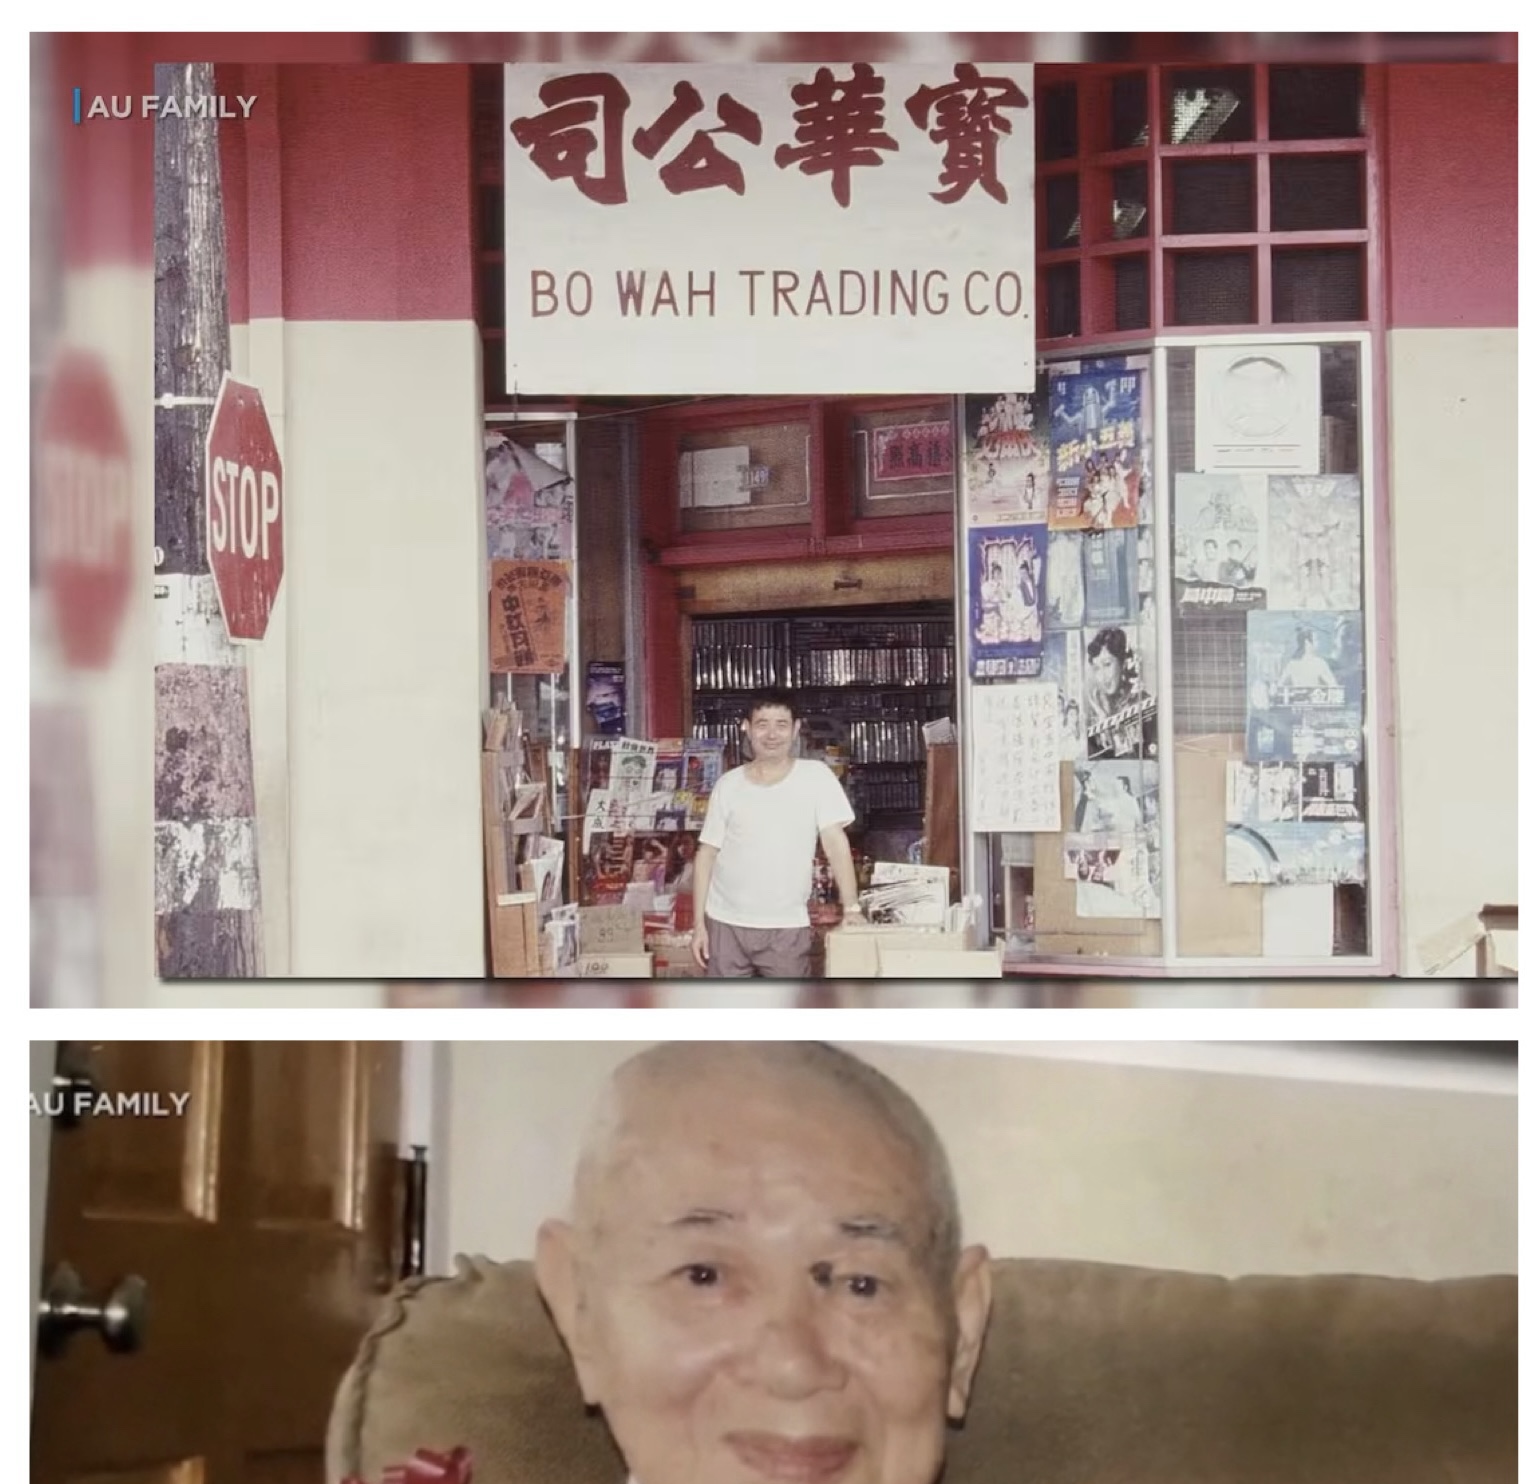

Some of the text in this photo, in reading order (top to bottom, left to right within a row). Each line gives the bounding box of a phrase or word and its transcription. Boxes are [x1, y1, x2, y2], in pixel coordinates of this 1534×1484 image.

[530, 270, 1029, 319] BO WAH TRADING CO.
[212, 456, 280, 561] STOP
